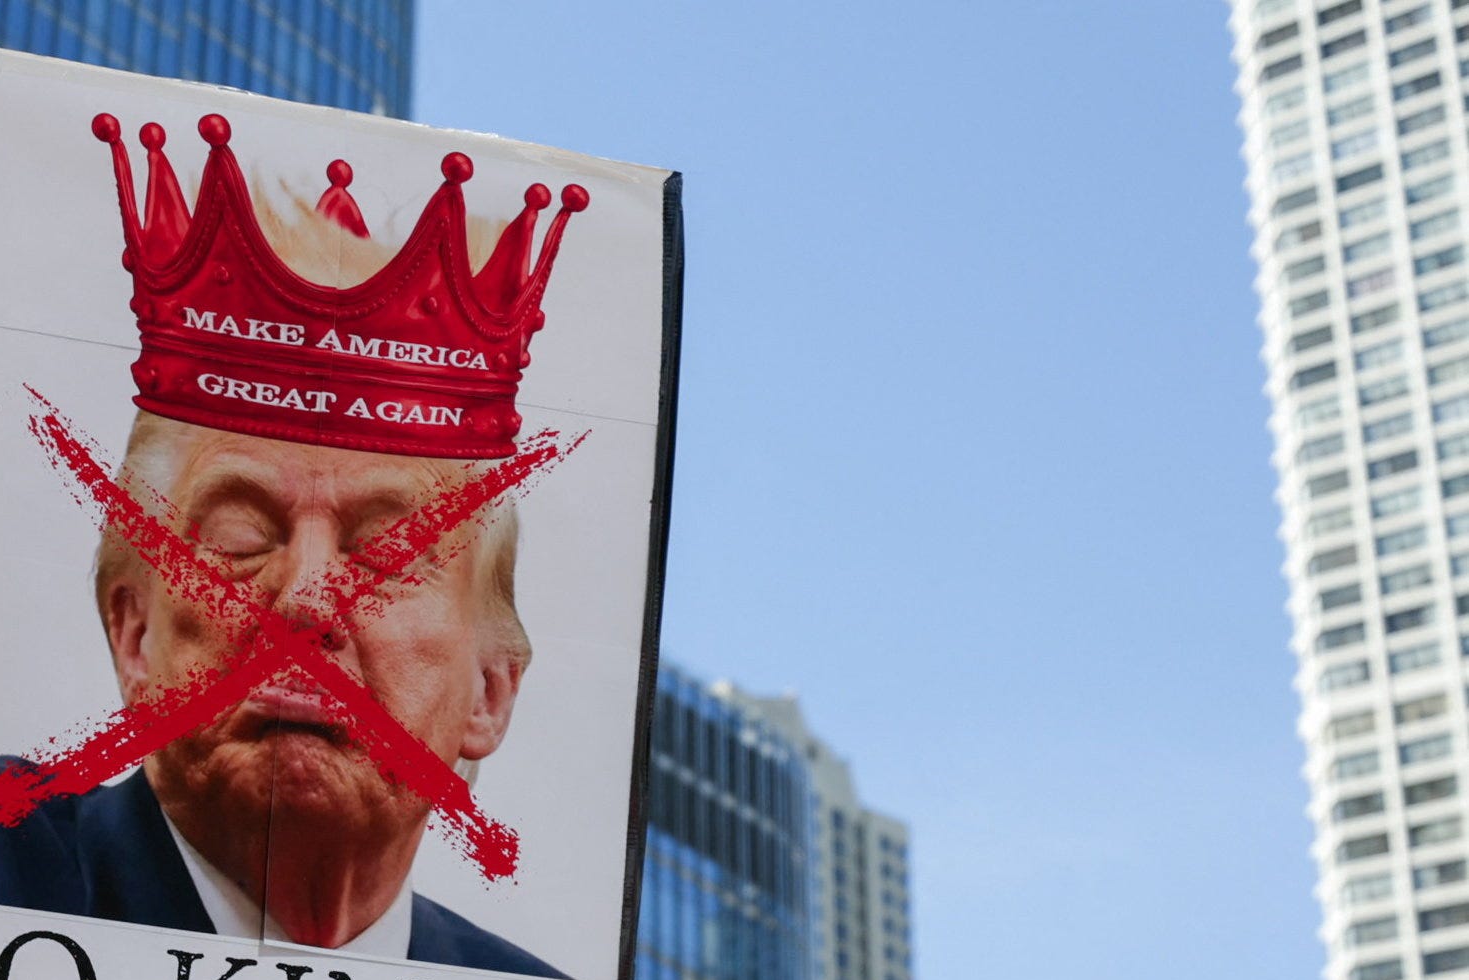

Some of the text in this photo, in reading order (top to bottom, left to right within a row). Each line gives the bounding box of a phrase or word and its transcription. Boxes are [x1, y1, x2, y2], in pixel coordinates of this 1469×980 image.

[183, 307, 489, 370] MAKE AMERICA
[197, 373, 463, 426] GREAT AGAIN
